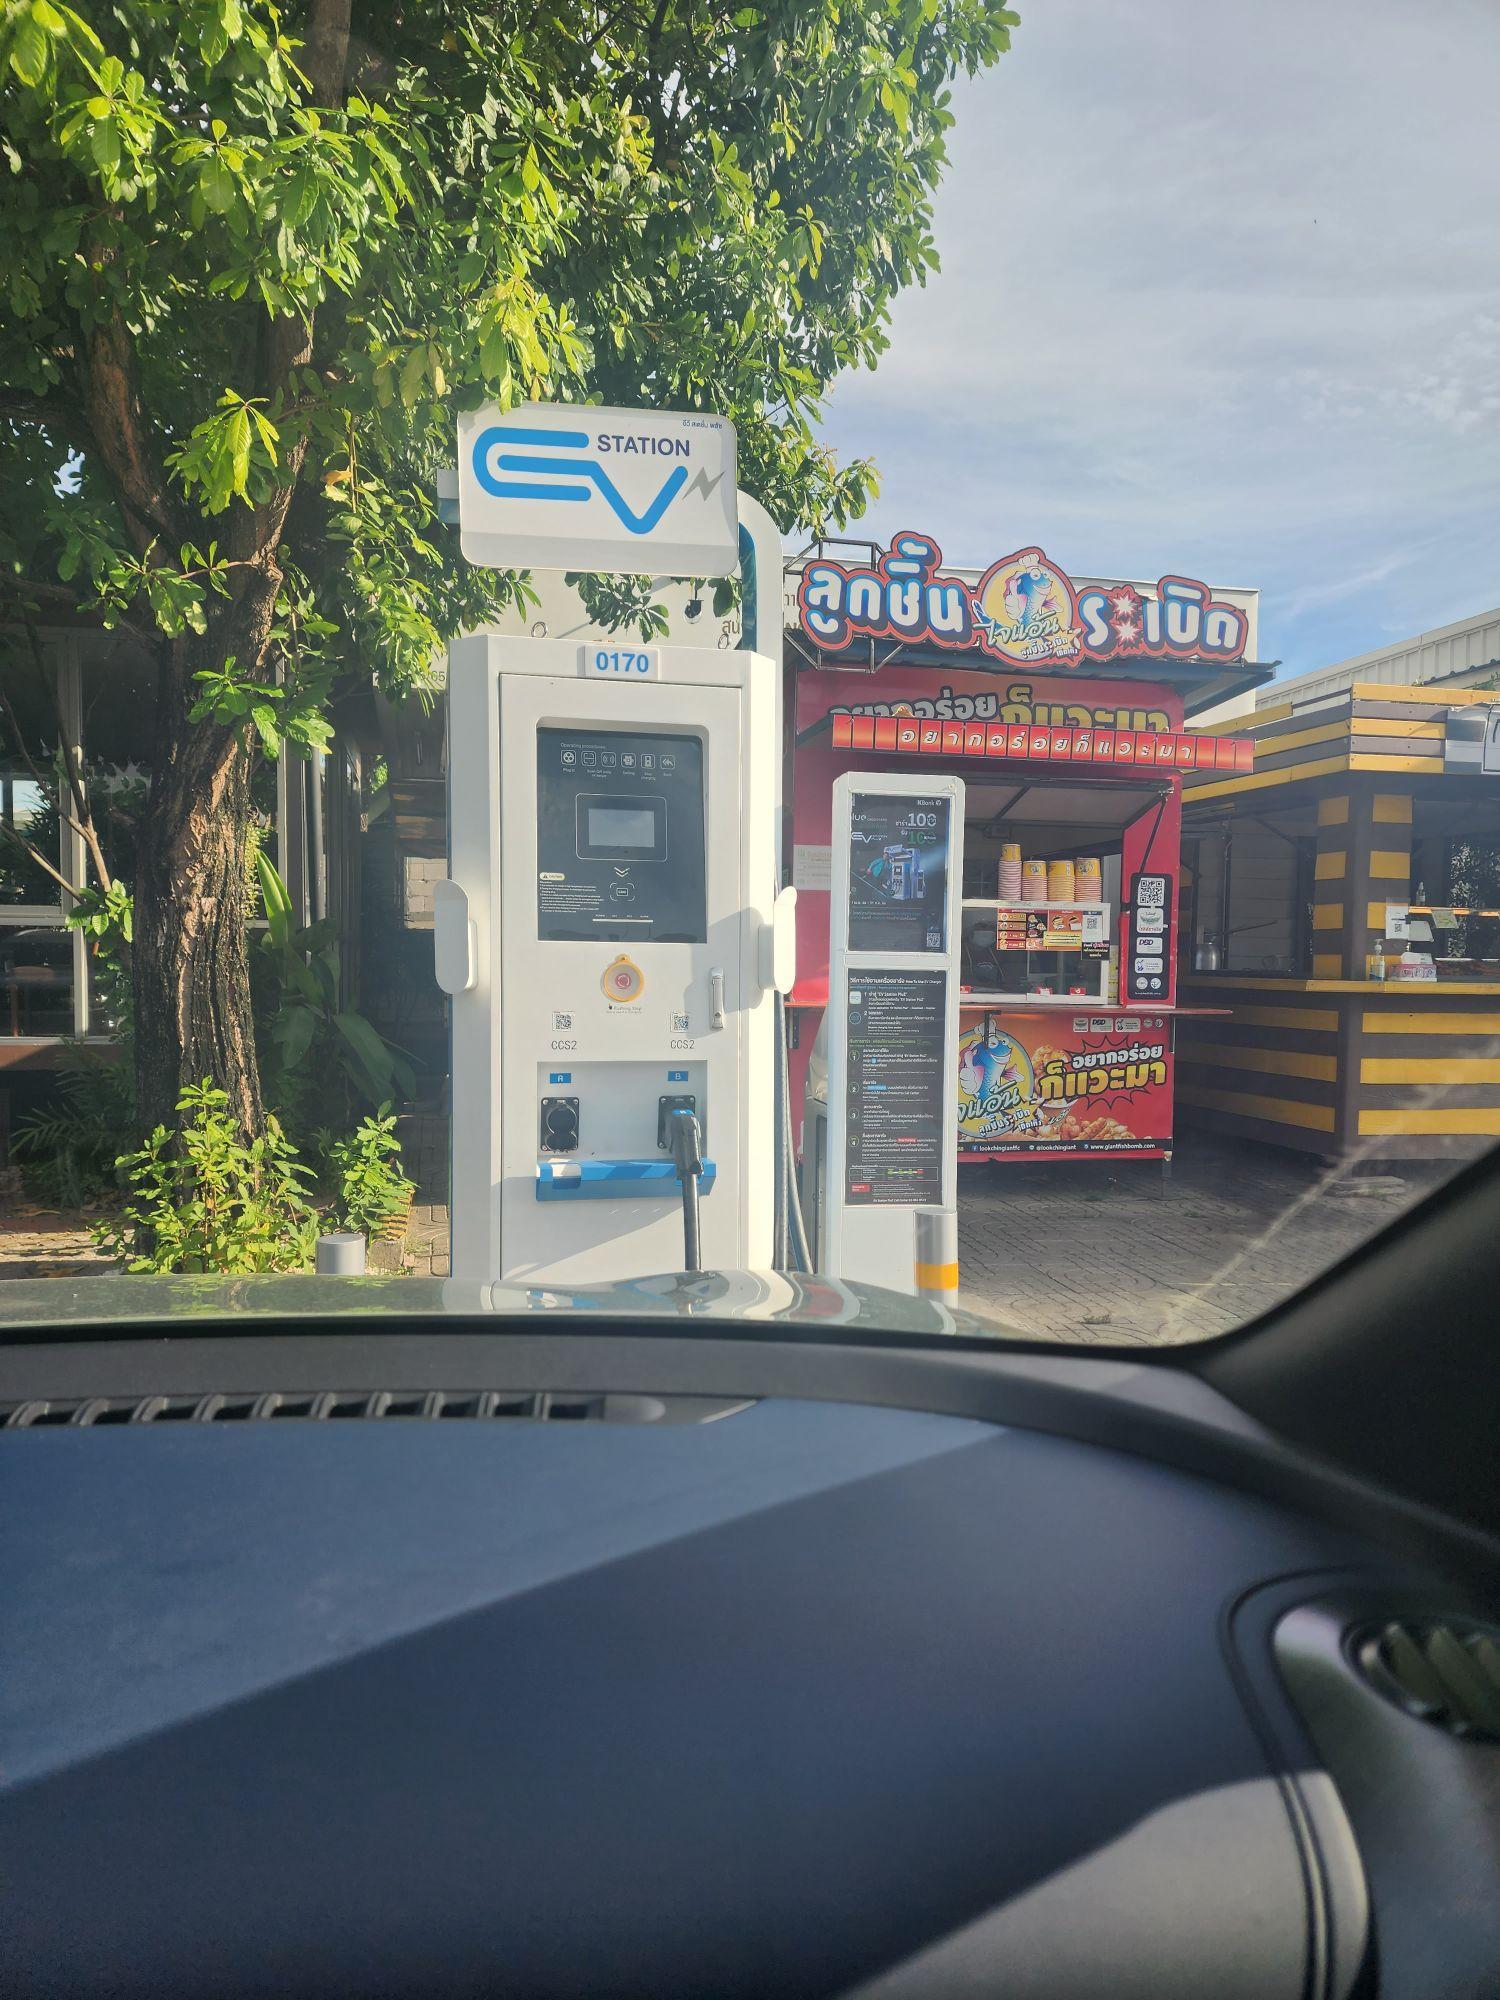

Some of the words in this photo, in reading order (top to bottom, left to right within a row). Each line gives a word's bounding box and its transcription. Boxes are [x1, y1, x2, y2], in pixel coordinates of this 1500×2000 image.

[598, 434, 690, 457] STATION
[473, 426, 688, 534] EV
[803, 536, 970, 638] ลูกชิ้น
[1080, 581, 1243, 650] ระเบิด
[596, 652, 649, 673] 0170
[908, 813, 937, 827] 100
[551, 1041, 577, 1050] CCS2
[670, 1040, 695, 1049] CCS2
[1072, 1043, 1163, 1069] อยากอร่อย
[557, 1075, 564, 1083] A
[1040, 1061, 1166, 1099] ก็แวะมา
[1090, 1143, 1156, 1151] www.giantfishbomb.com
